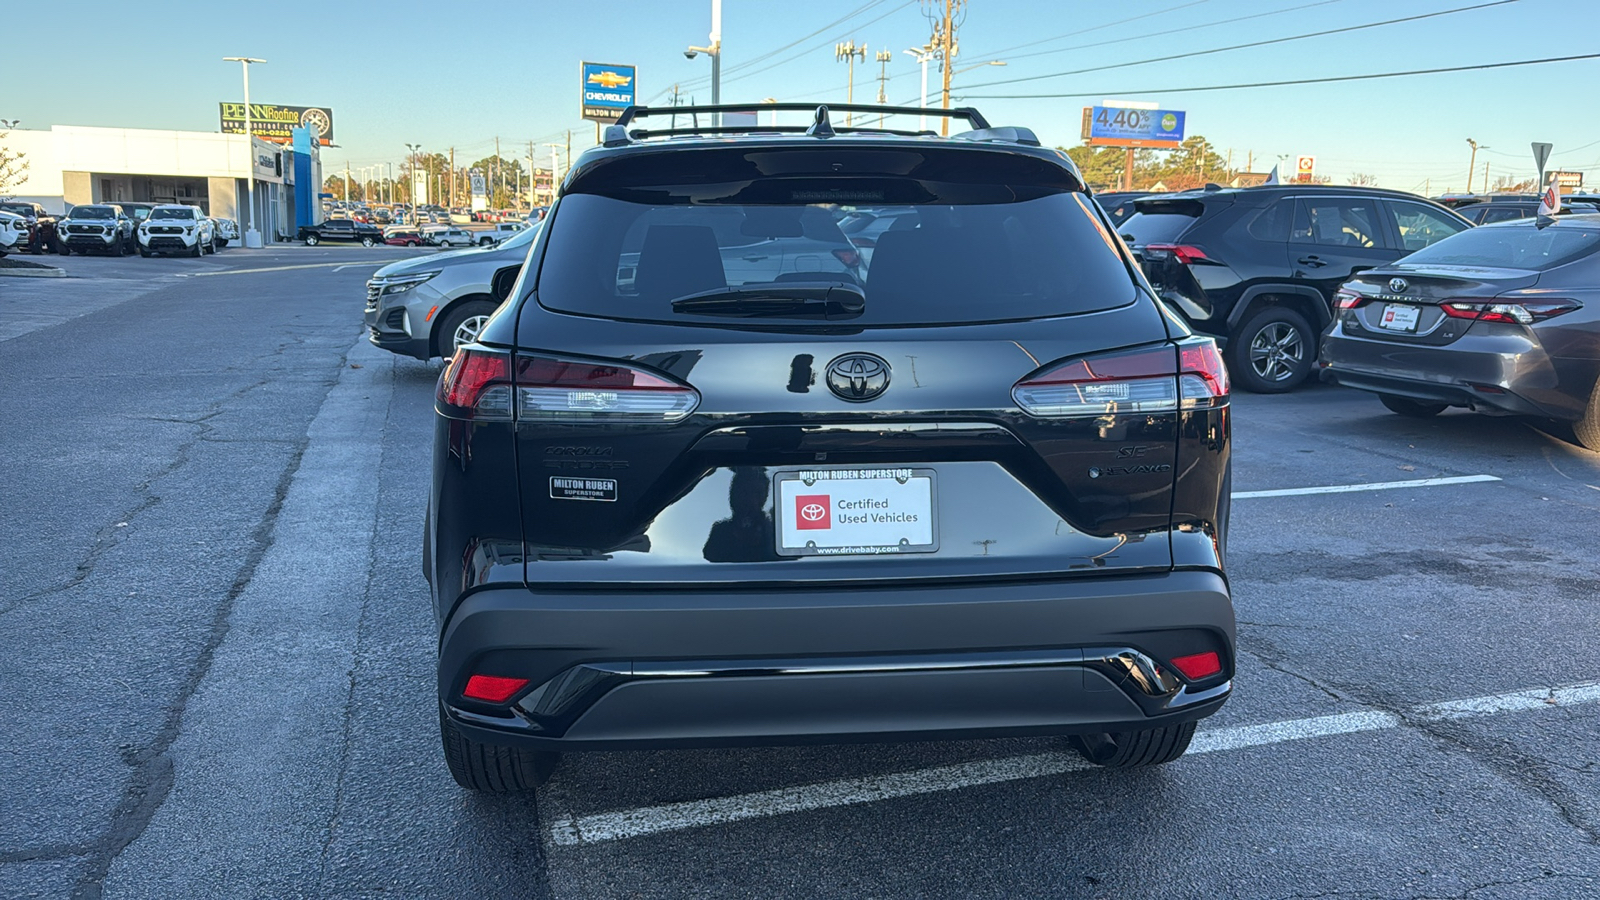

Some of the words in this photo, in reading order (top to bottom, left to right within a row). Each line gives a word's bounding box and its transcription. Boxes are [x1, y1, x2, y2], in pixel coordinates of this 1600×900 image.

[586, 92, 631, 102] CHEVROLET
[268, 107, 299, 123] Roofing
[585, 108, 609, 117] MILTON
[545, 446, 613, 456] COROLLA
[1117, 445, 1147, 459] SE
[799, 471, 830, 480] MILTON
[831, 470, 859, 480] RUBEN
[860, 469, 913, 479] SUPERSTORE
[553, 479, 584, 489] MILTON
[585, 481, 613, 491] RUBEN
[564, 489, 604, 497] SUPERSTORE
[838, 498, 889, 510] Certified
[838, 514, 868, 524] Used
[871, 512, 918, 523] Vehicles
[817, 546, 899, 555] www.drivebaby.com
